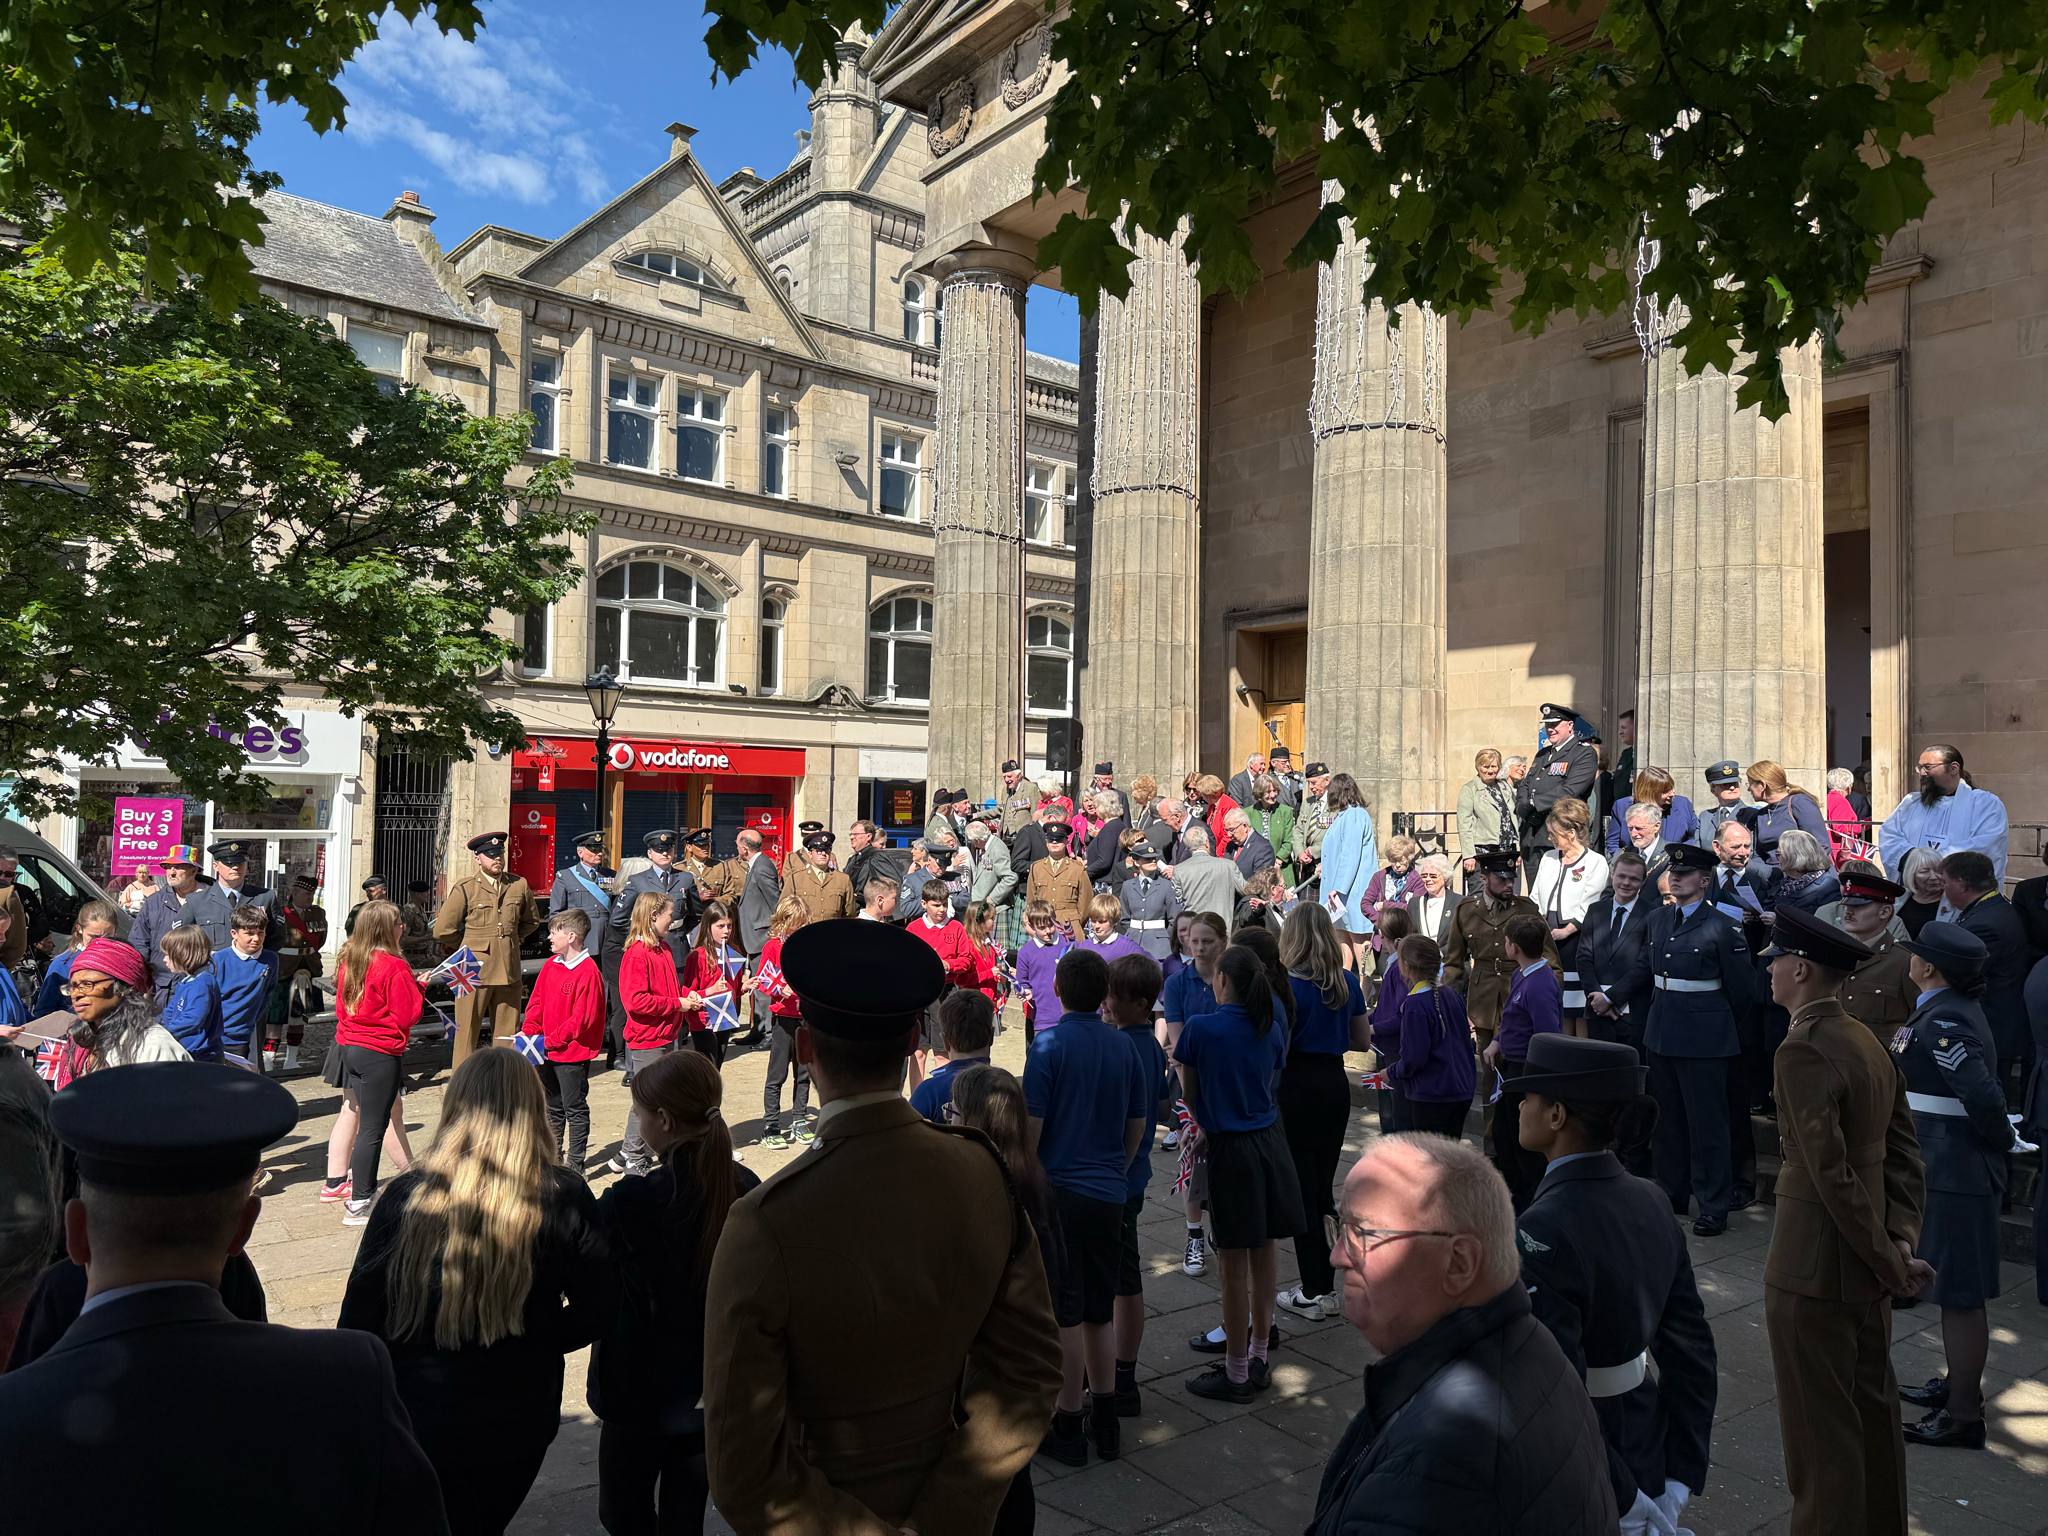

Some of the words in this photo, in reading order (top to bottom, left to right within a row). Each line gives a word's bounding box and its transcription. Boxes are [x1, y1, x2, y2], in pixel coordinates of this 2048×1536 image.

[640, 748, 729, 768] vodafone
[121, 808, 155, 824] Buy
[161, 809, 173, 822] 3
[119, 823, 151, 836] Get
[157, 823, 169, 836] 3
[119, 837, 158, 850] Free
